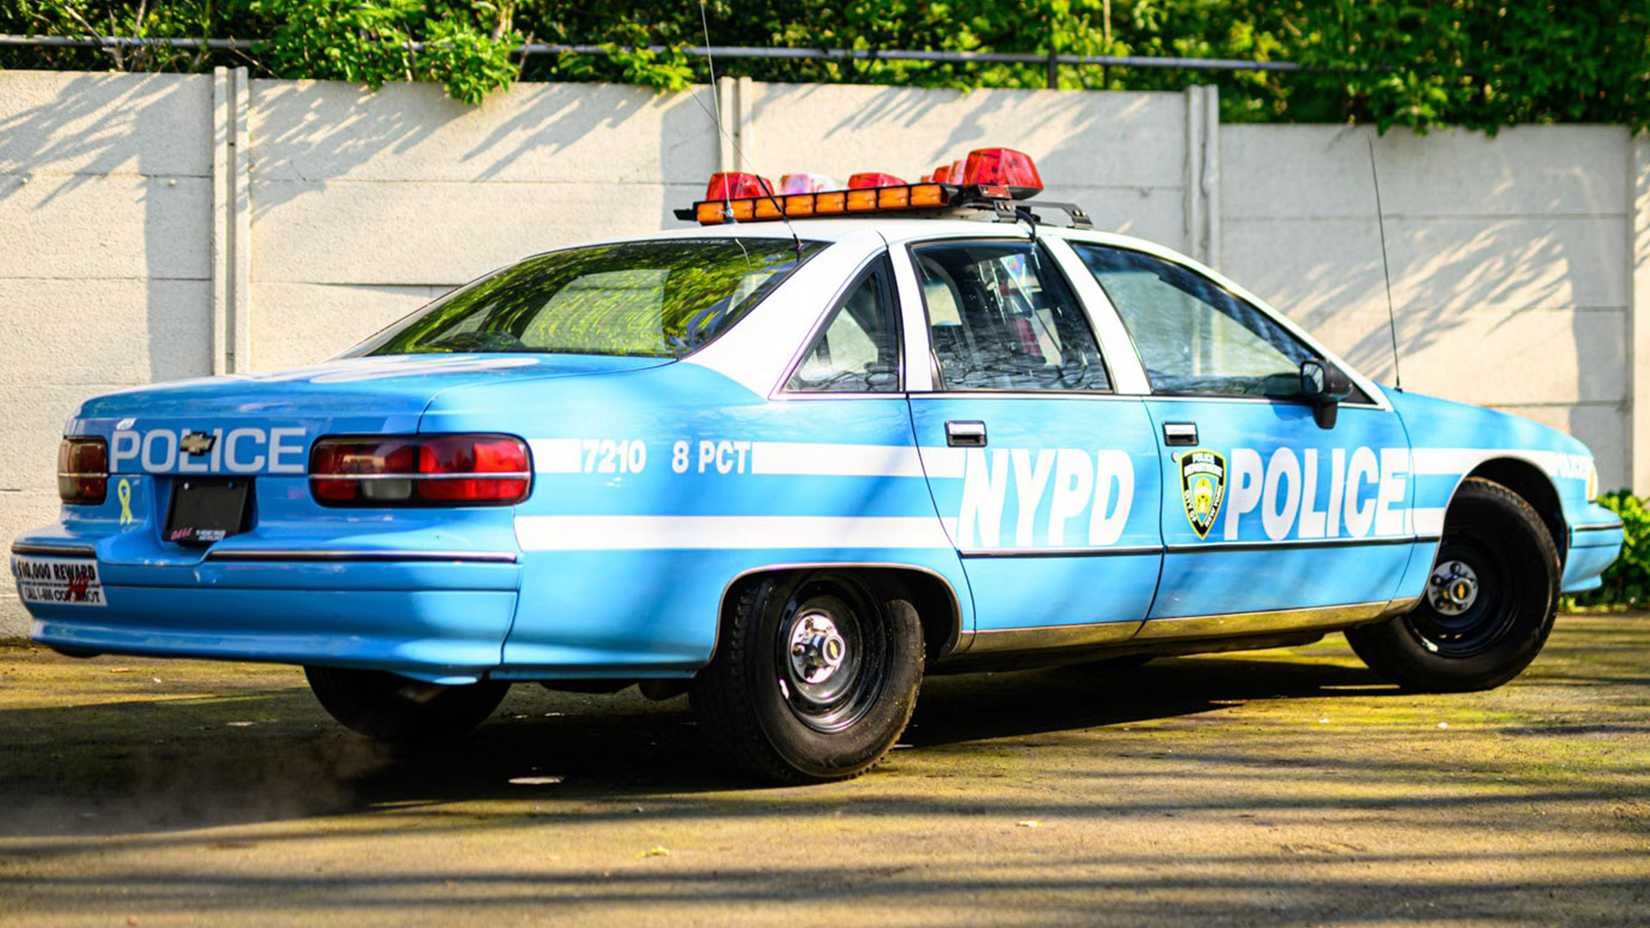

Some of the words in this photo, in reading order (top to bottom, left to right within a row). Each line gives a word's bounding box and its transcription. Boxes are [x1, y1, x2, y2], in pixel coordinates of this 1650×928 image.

[109, 427, 306, 473] POLICE
[583, 440, 647, 473] 7210
[671, 440, 689, 473] 8
[698, 440, 752, 474] PCT
[957, 447, 1136, 547] NYPD
[1223, 447, 1406, 541] POLICE
[52, 563, 96, 581] REWARD
